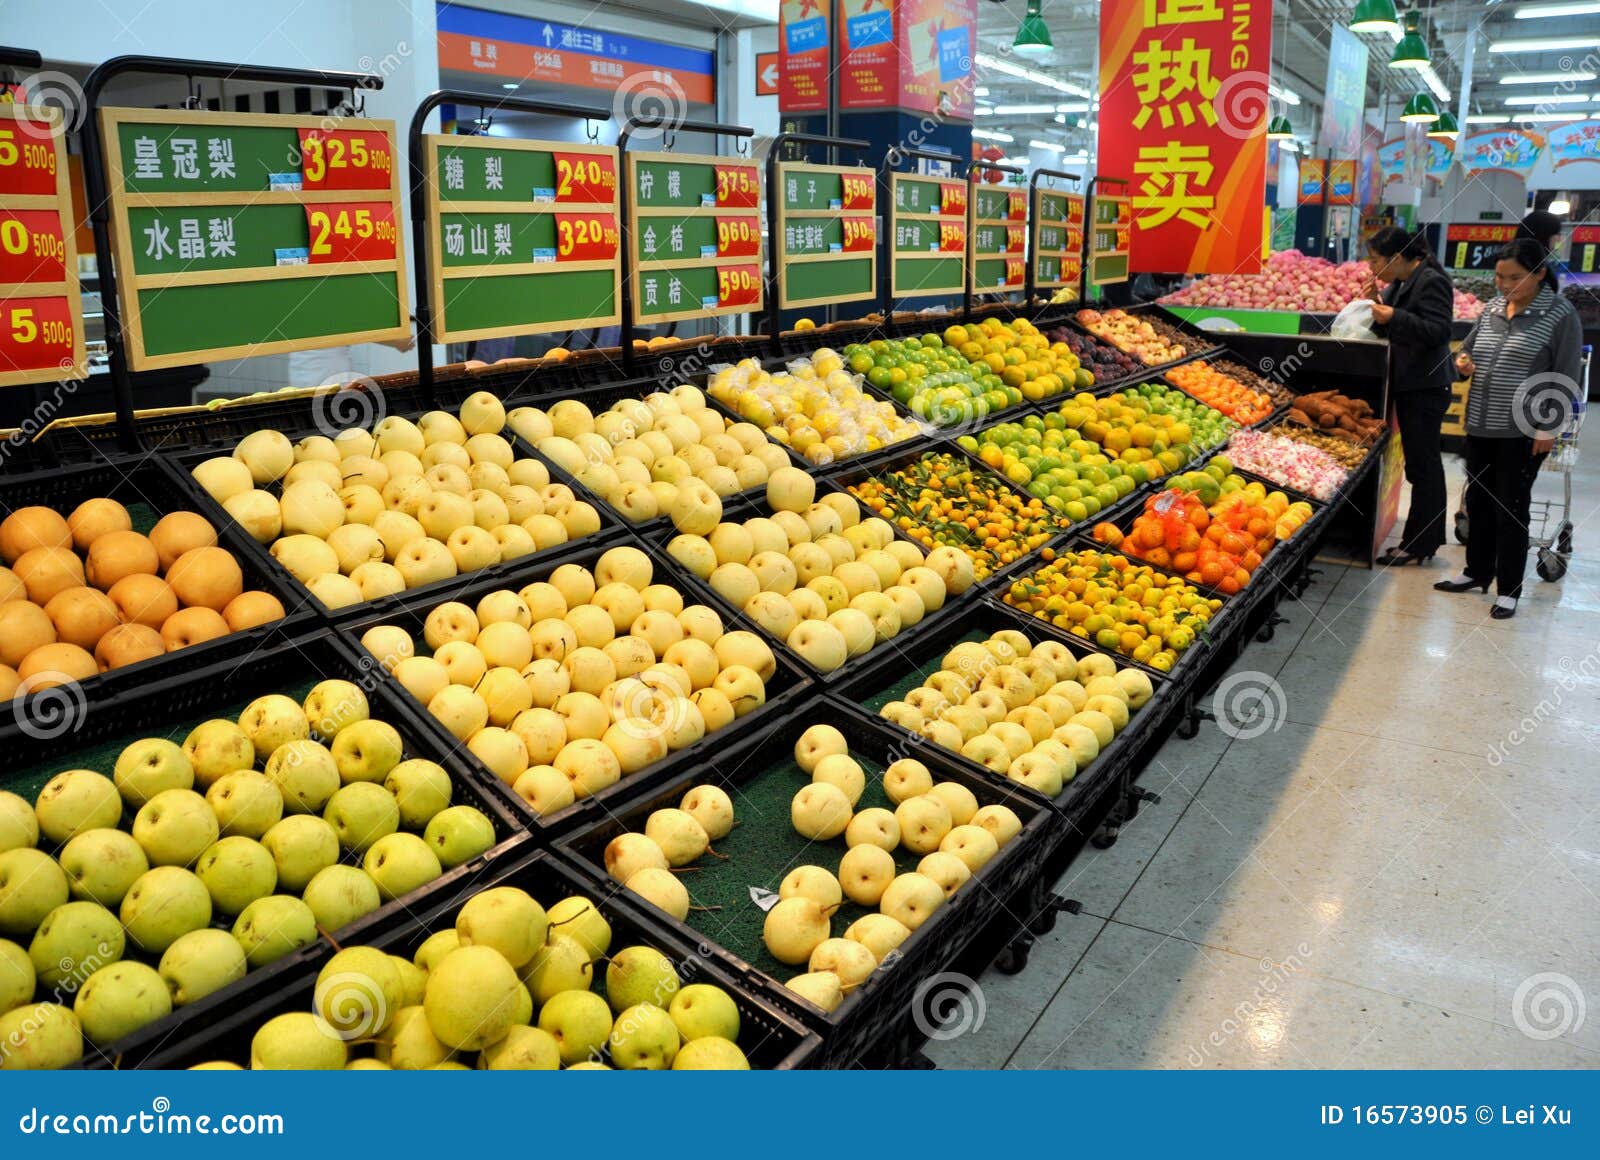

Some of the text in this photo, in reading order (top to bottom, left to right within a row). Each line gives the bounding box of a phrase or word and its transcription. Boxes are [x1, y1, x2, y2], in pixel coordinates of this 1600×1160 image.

[1231, 0, 1250, 70] ING
[24, 144, 55, 175] 500g
[134, 136, 236, 179] 皇冠梨
[304, 139, 369, 182] 325
[371, 150, 391, 174] 500g
[444, 155, 503, 191] 糖梨
[558, 159, 601, 196] 240
[640, 170, 681, 199] 柠檬
[719, 171, 749, 202] 375
[844, 178, 867, 206] 550
[33, 233, 65, 262] 500g
[144, 217, 237, 261] 水晶梨
[311, 209, 397, 255] 245 500g
[445, 223, 512, 257] 砀山梨
[559, 219, 603, 256] 320
[643, 224, 684, 253] 金桔
[720, 221, 750, 252] 960
[844, 221, 867, 248] 390
[645, 278, 683, 306] 贡桔
[720, 271, 751, 301] 590
[0, 309, 73, 348] 5 500g
